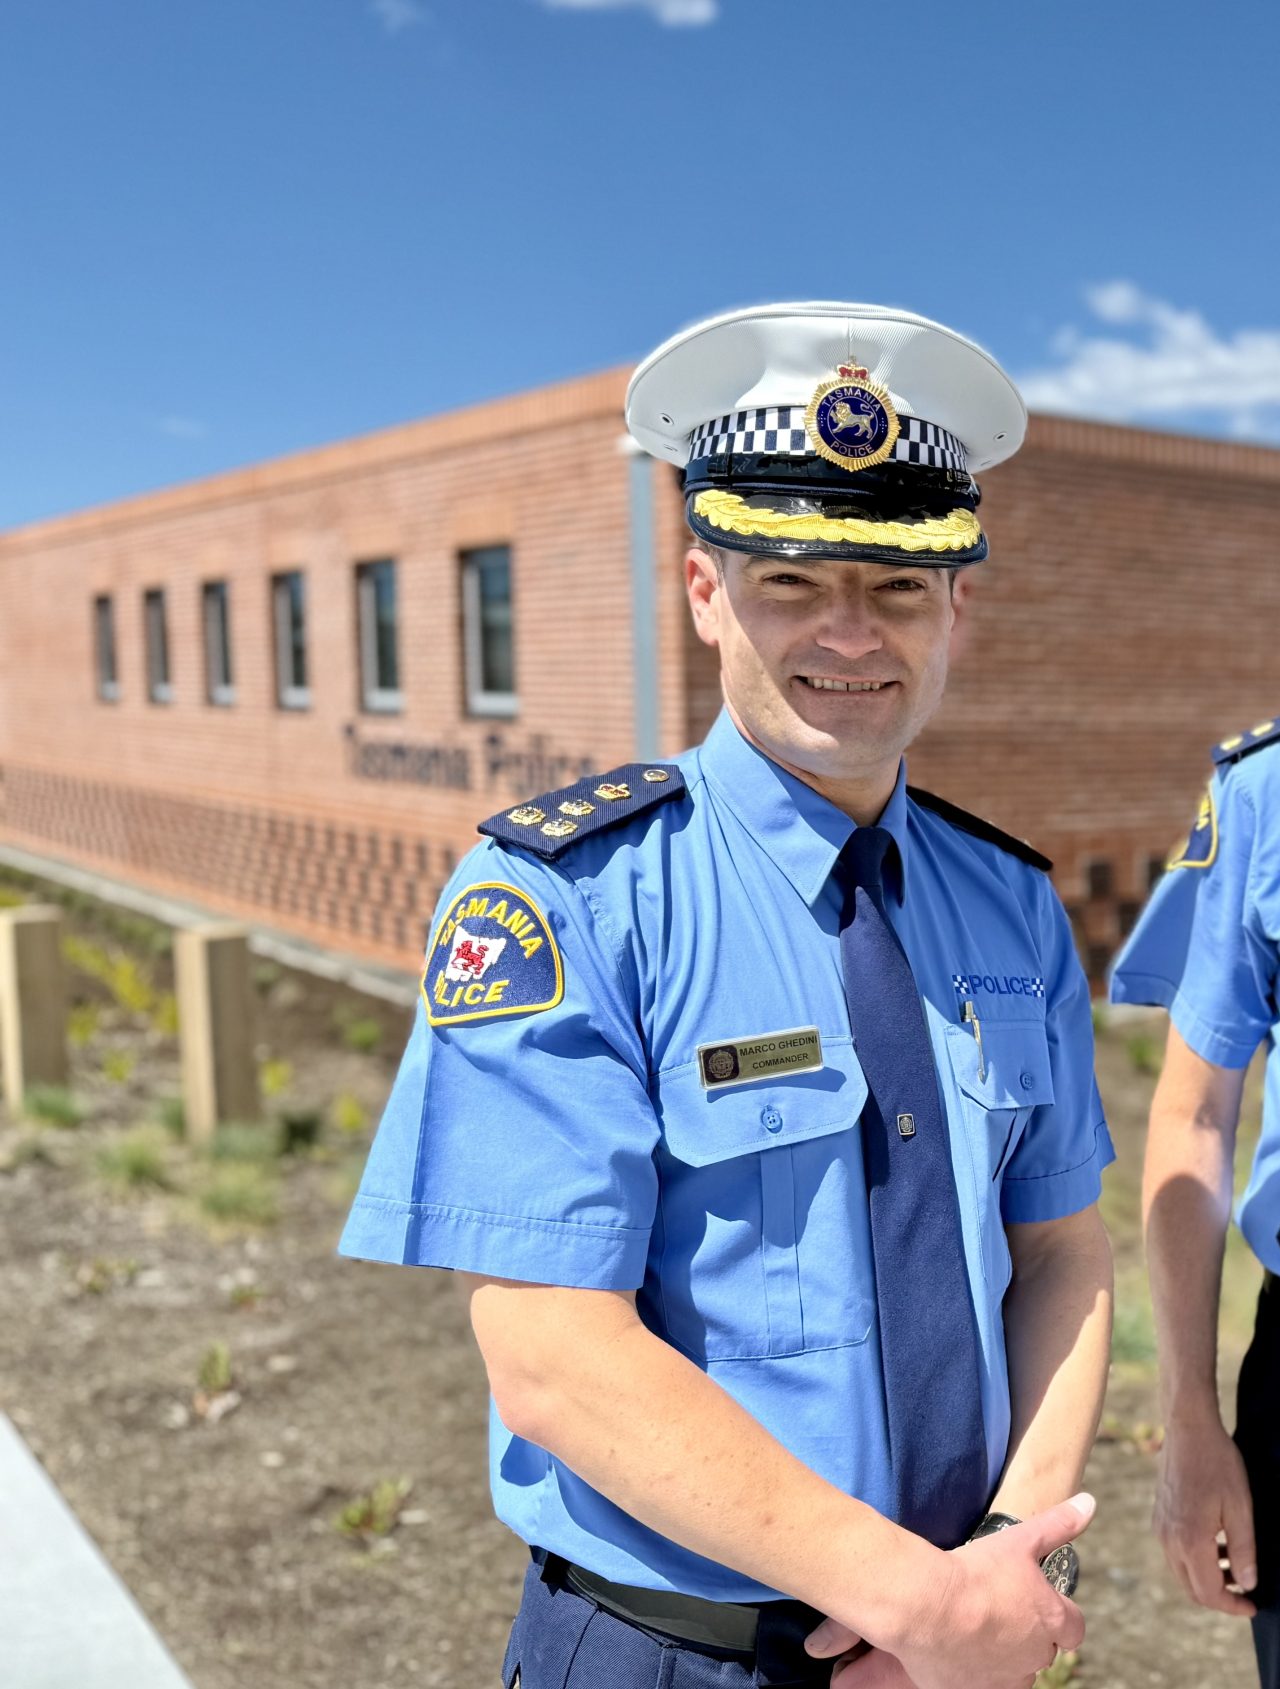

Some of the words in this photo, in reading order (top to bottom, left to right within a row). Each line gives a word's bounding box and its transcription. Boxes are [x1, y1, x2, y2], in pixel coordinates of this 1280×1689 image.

[821, 387, 881, 412] TASMANIA
[830, 440, 875, 457] POLICE
[434, 971, 510, 1007] LICE
[968, 974, 1032, 996] POLICE
[740, 1042, 776, 1057] MARCO
[778, 1035, 818, 1050] GHEDINI
[752, 1052, 809, 1070] COMMANDER
